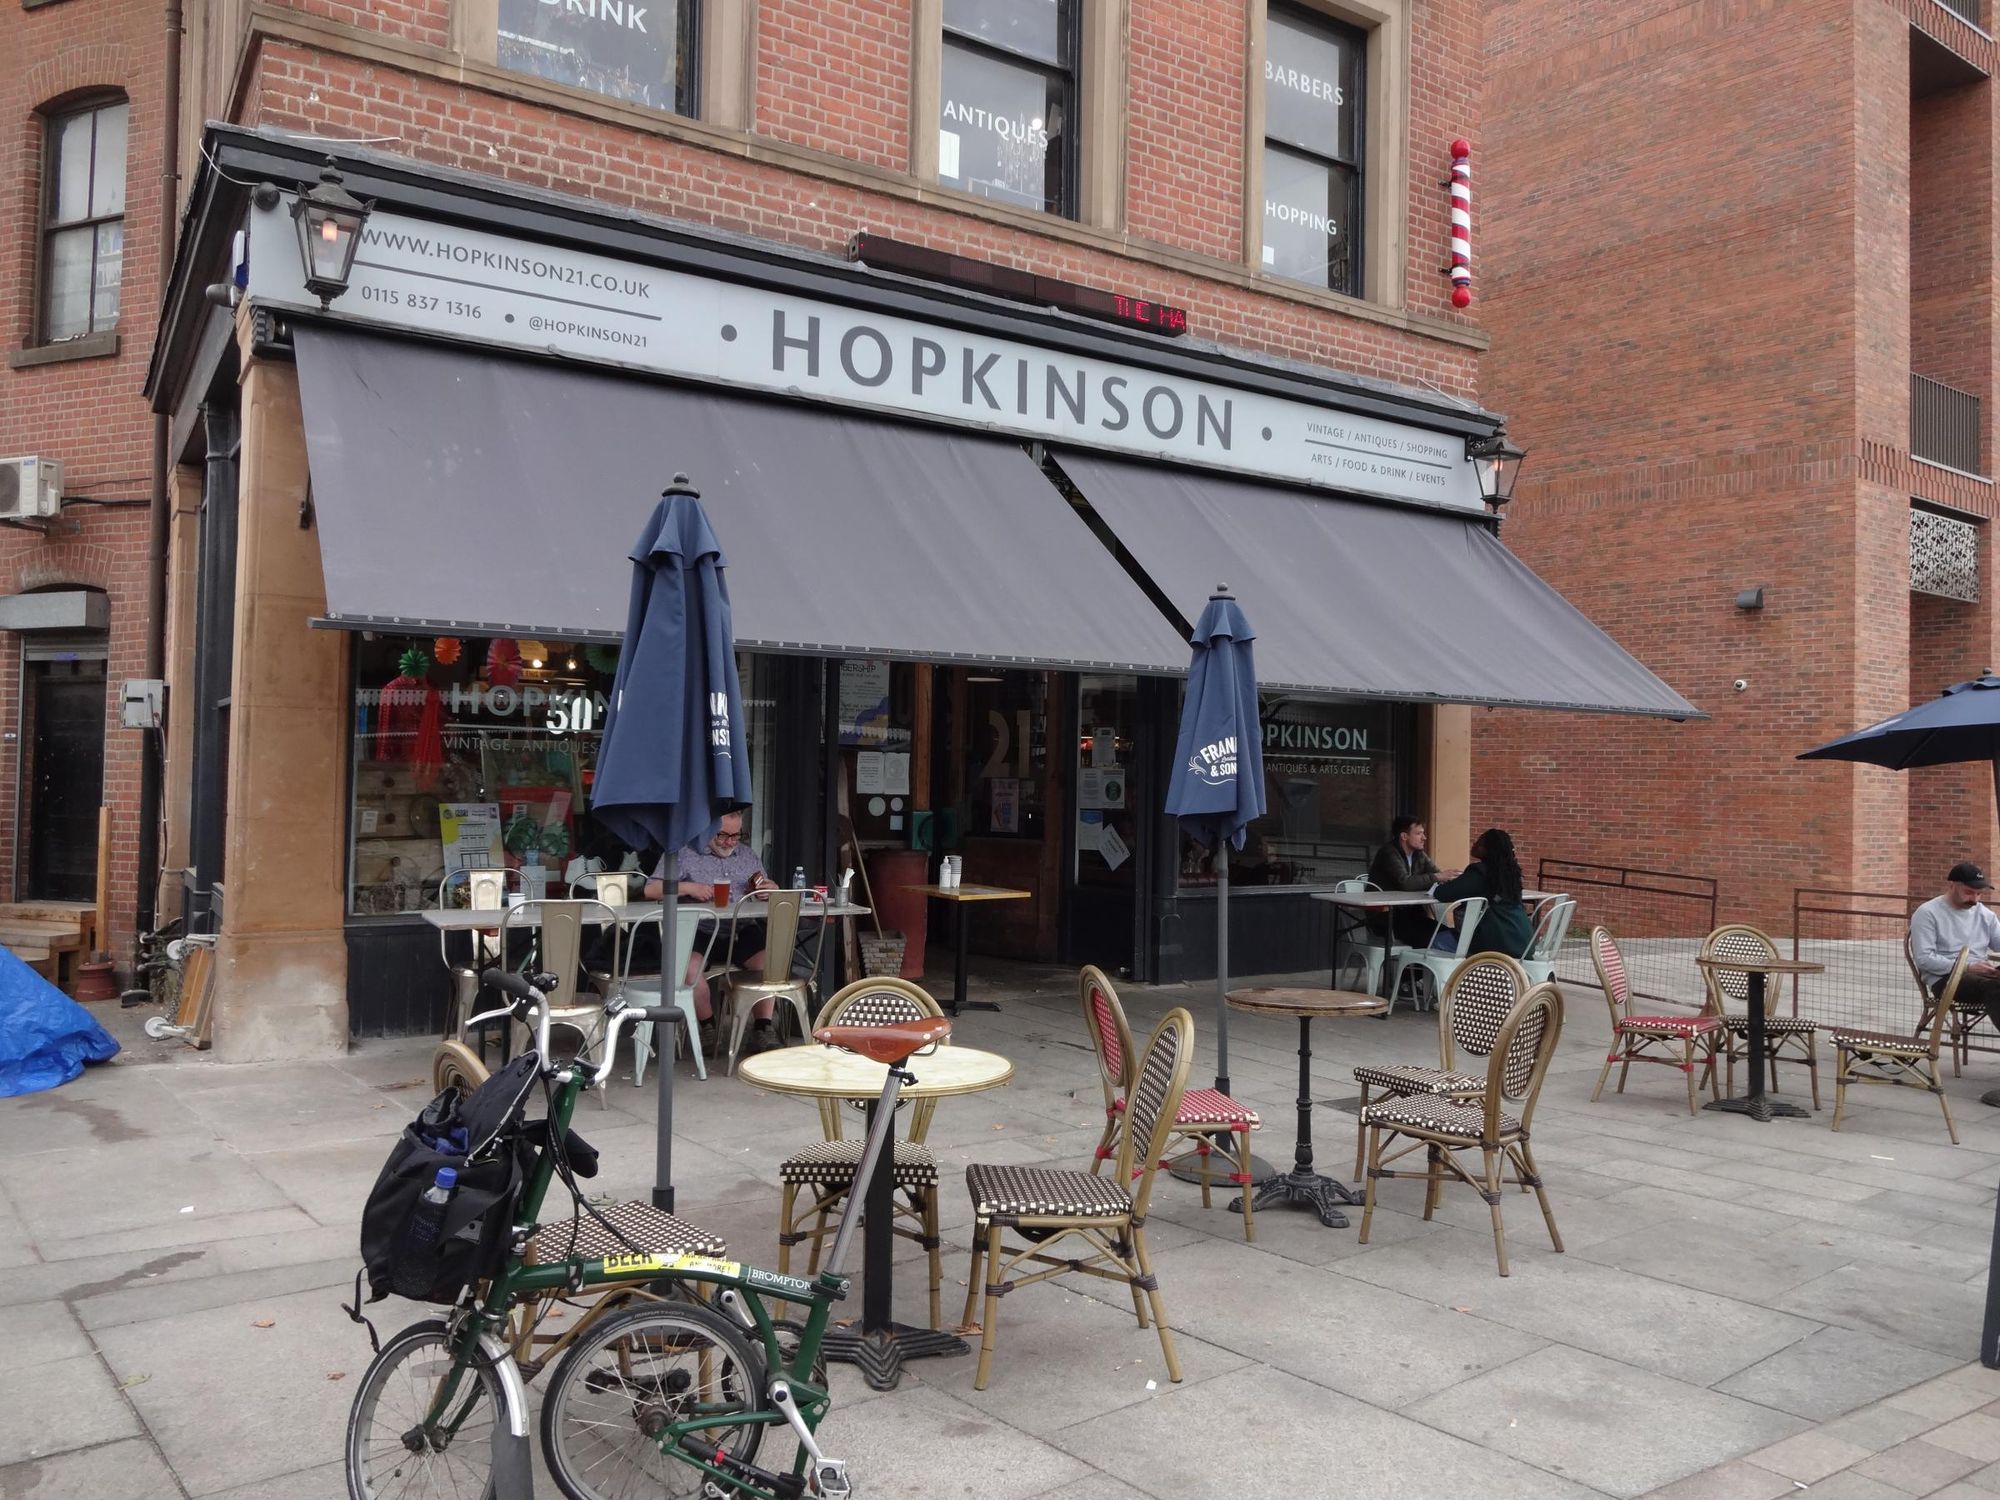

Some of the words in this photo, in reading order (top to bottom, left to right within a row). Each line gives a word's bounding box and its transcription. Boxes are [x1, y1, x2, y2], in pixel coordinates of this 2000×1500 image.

[1264, 60, 1344, 106] BARBERS
[943, 99, 1049, 149] ANTIQUES
[360, 228, 650, 298] WWW.HOPKINSON21.CO.UK
[361, 285, 399, 305] 0115
[407, 293, 439, 311] 837
[446, 300, 482, 319] 1316
[529, 315, 648, 348] @HOPKINSON21
[771, 309, 1233, 451] HOPKINSON
[1306, 422, 1345, 439] VINTAGE
[1354, 432, 1398, 449] ANTIQUES
[1407, 442, 1448, 459] SHOPPING
[1311, 453, 1333, 466] ARTS
[1342, 458, 1368, 472] FOOD
[1370, 464, 1378, 474] &
[1380, 465, 1407, 479] DRINK
[1416, 472, 1446, 486] EVENTS
[1200, 736, 1238, 764] FRAN
[1260, 723, 1368, 751] PKINSON
[1210, 765, 1219, 778] &
[1266, 763, 1308, 775] ANTIQUES
[1319, 764, 1338, 775] ARTS
[1340, 765, 1371, 776] CENTRE
[751, 1268, 813, 1291] BROMPTON
